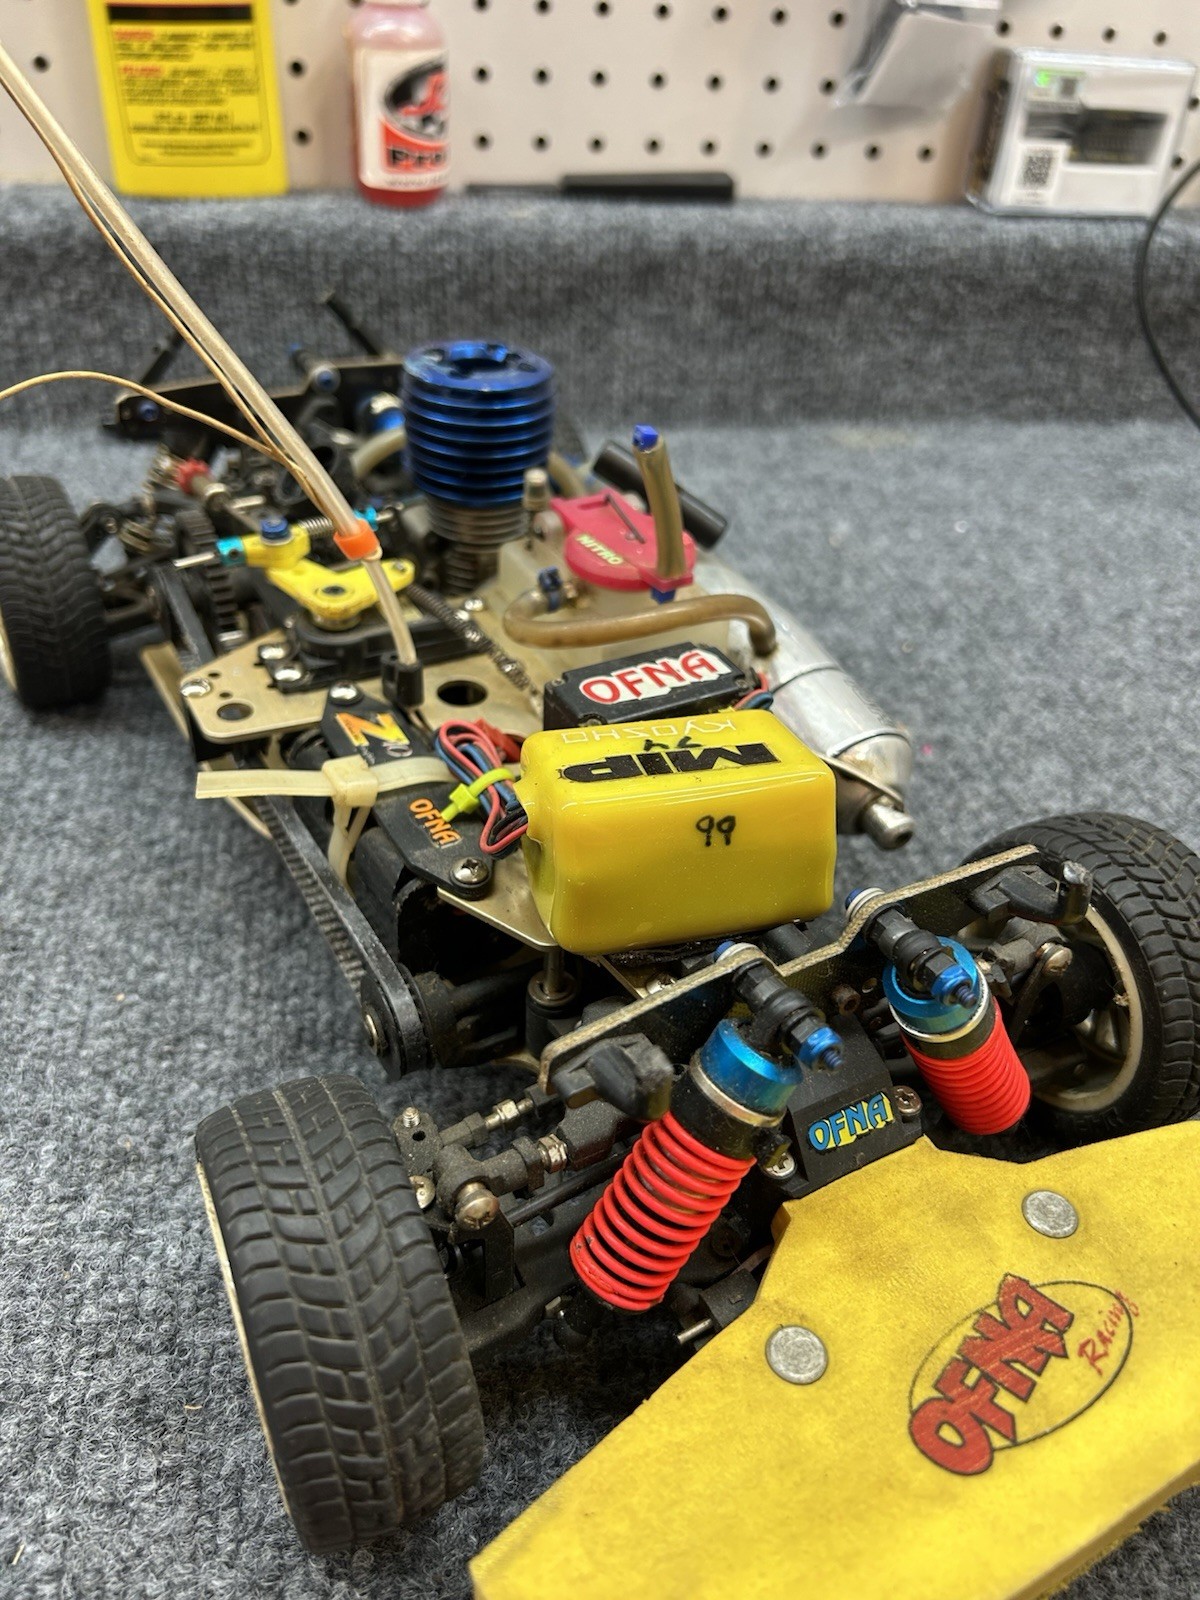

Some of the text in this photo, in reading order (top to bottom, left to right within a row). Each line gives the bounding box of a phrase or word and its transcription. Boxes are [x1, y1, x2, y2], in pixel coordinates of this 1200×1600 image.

[575, 533, 625, 565] NITRO
[580, 650, 728, 704] OFNA
[560, 718, 737, 744] KYOSHO
[562, 742, 780, 783] MIP
[409, 797, 463, 848] OFNA
[695, 814, 737, 847] 99
[807, 1091, 892, 1151] OFNA
[908, 1272, 1075, 1476] OFNA
